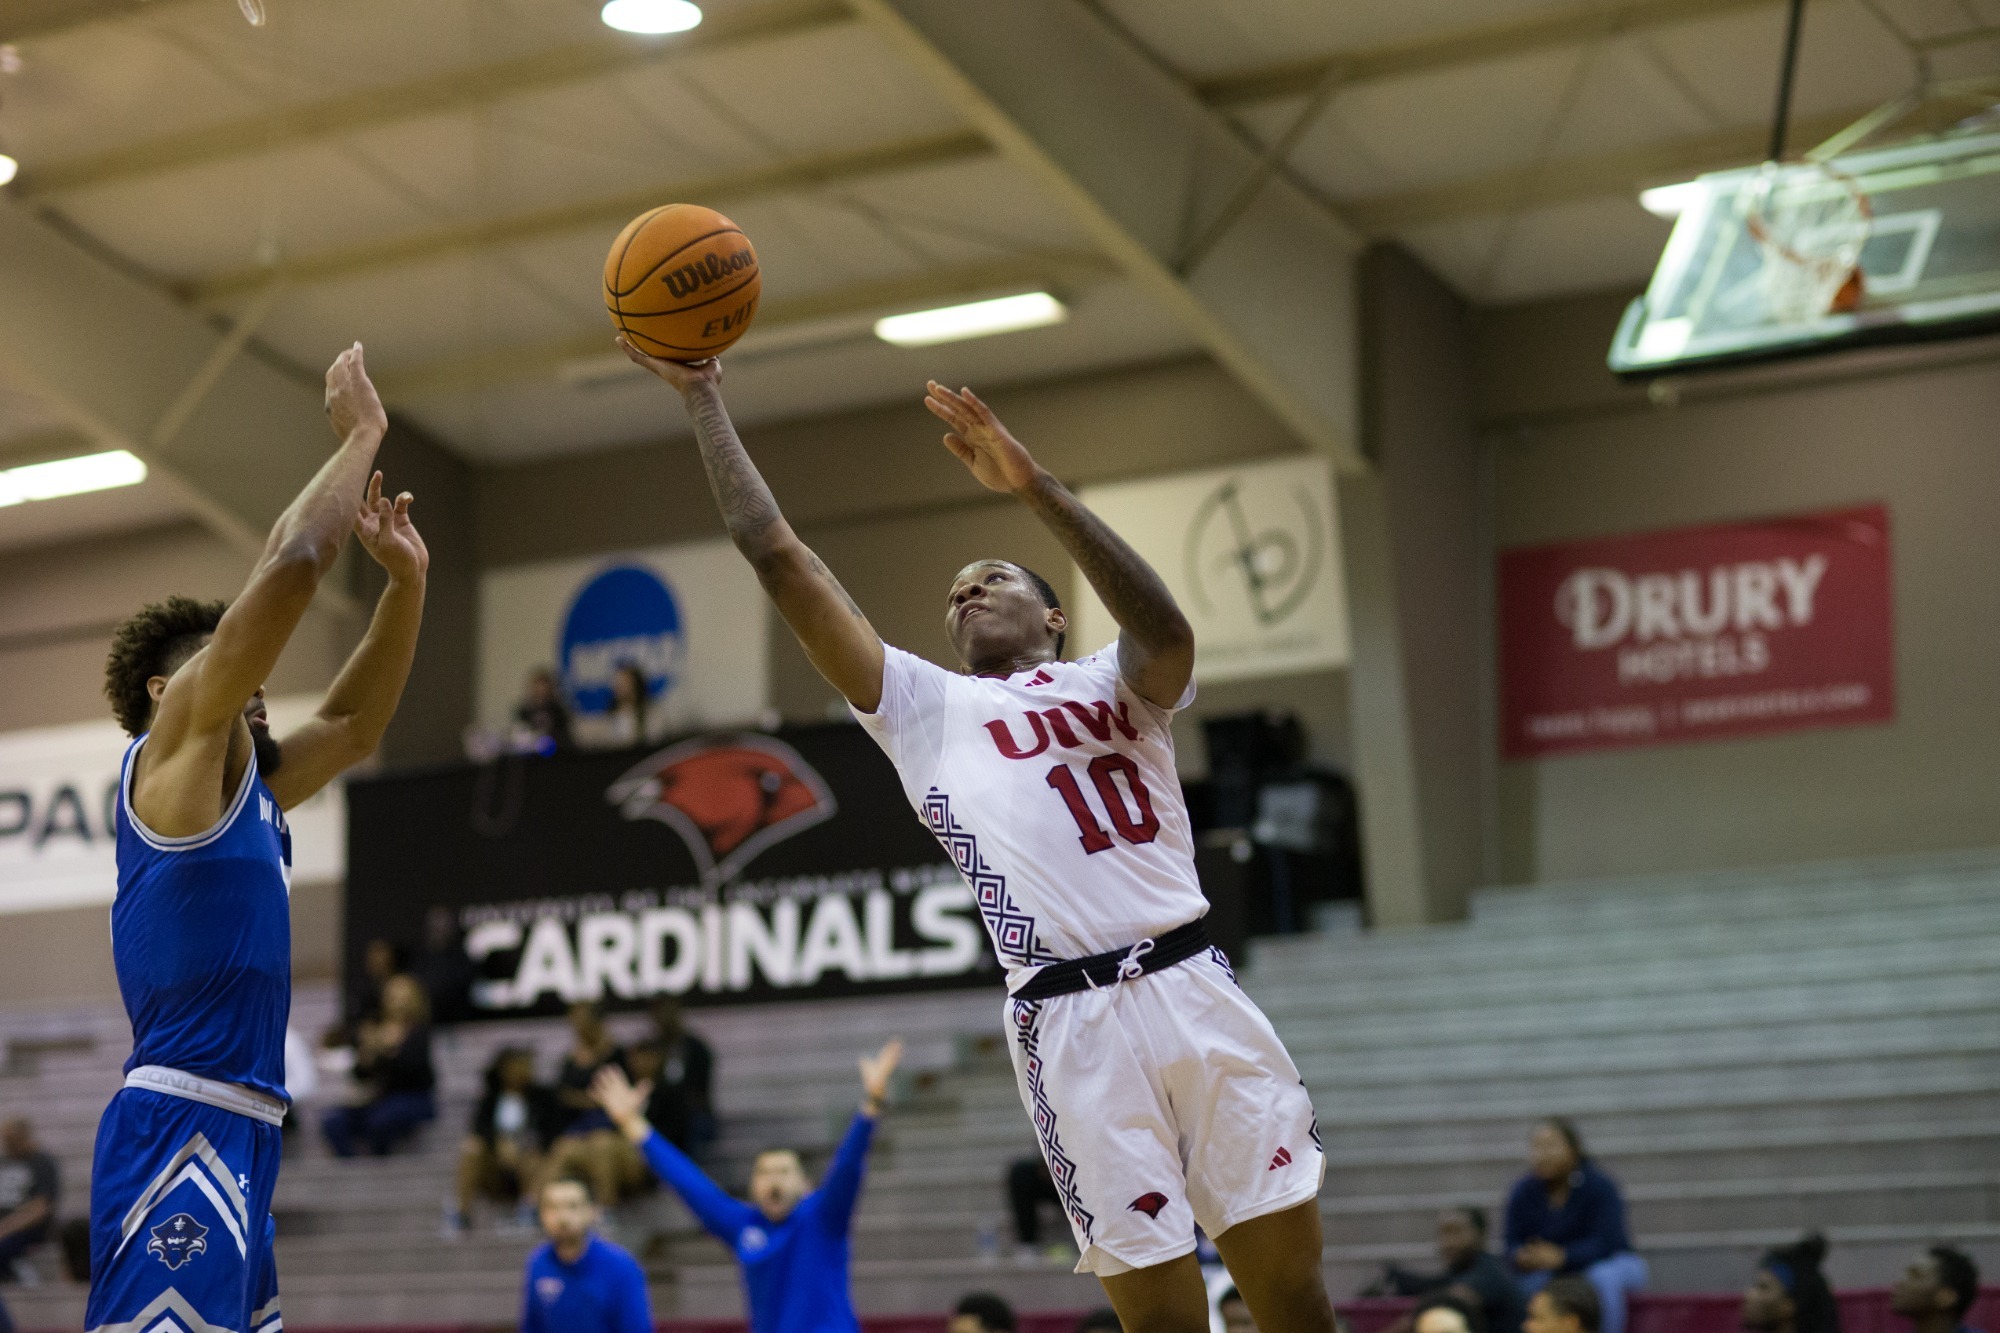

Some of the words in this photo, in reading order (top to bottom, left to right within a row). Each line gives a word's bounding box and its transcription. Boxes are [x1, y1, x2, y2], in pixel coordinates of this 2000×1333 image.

[661, 248, 754, 299] Wilson
[1556, 553, 1827, 650] DRURY
[1618, 634, 1769, 687] HOTELS
[982, 700, 1138, 760] UIW
[1045, 753, 1160, 855] 10
[464, 882, 982, 1009] CARDINALS
